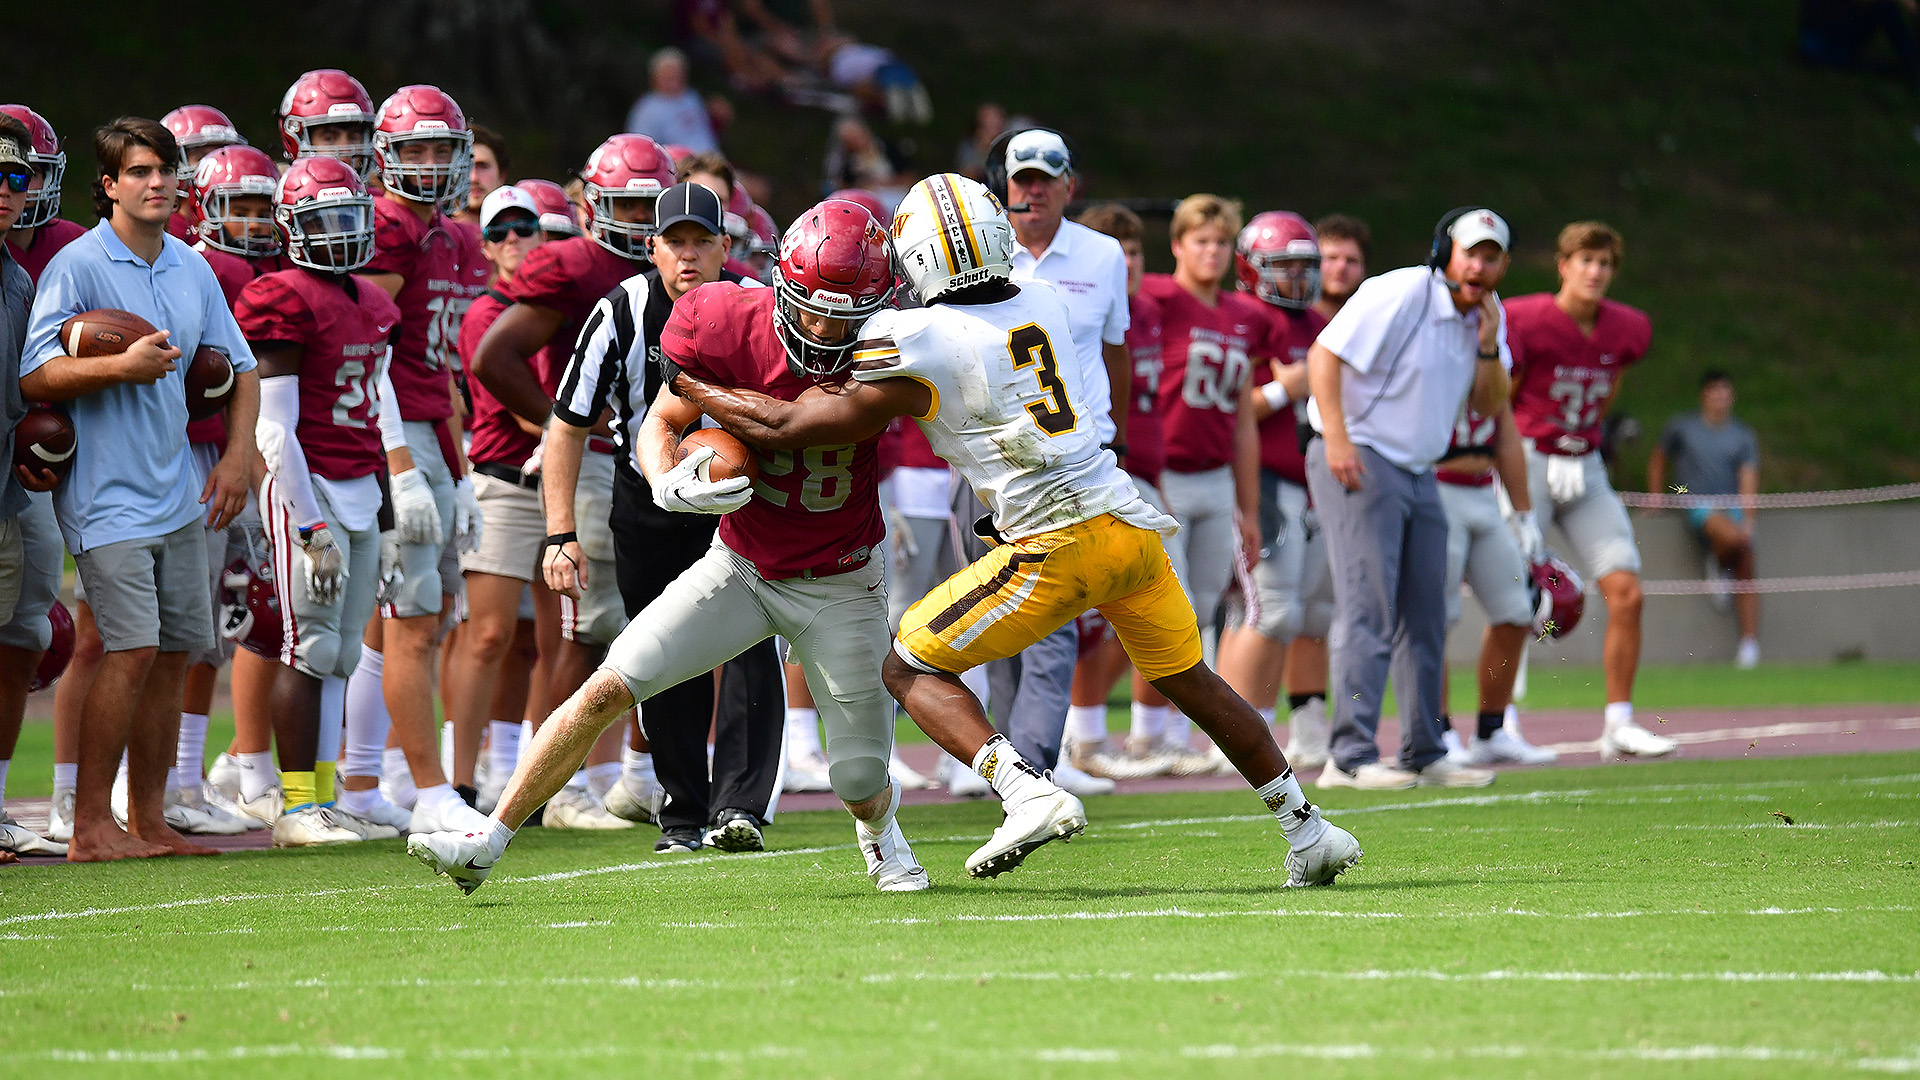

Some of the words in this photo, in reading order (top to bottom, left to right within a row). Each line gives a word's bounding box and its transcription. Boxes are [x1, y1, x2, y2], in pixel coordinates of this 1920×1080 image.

[817, 293, 849, 305] Riddell
[1006, 321, 1078, 438] 3
[1181, 341, 1251, 414] 60
